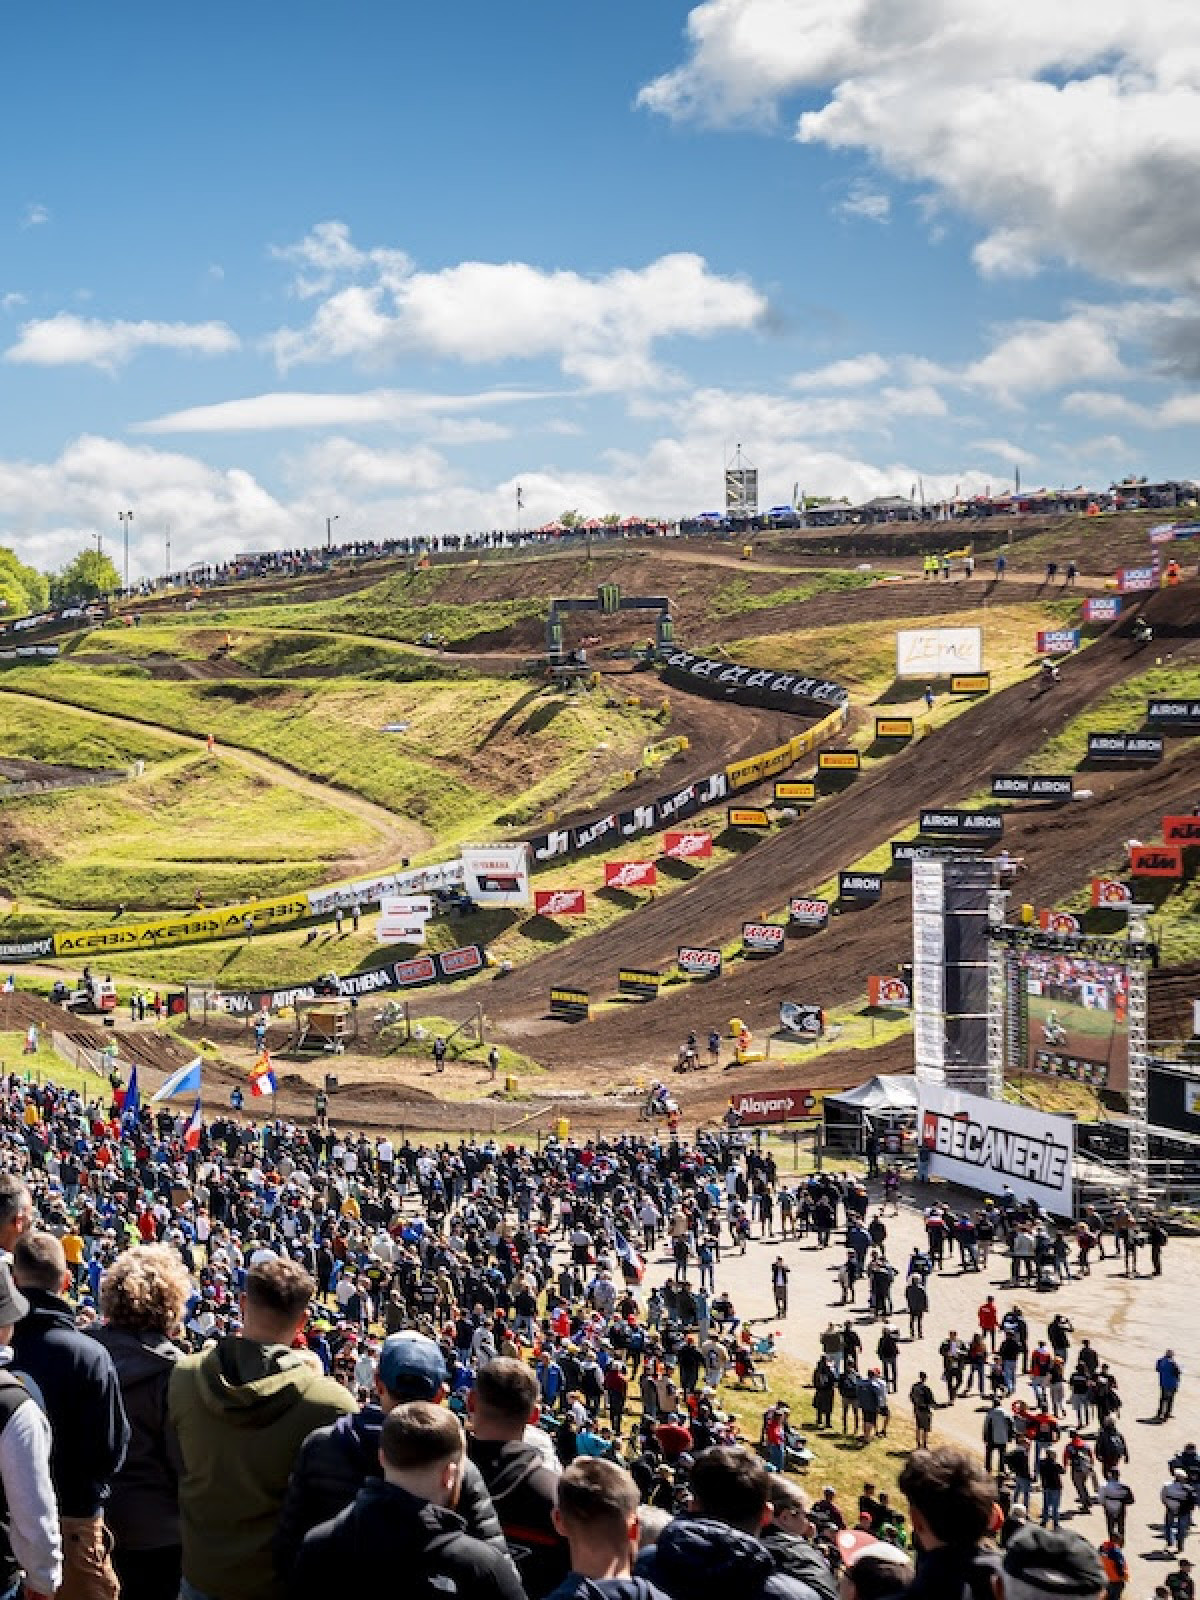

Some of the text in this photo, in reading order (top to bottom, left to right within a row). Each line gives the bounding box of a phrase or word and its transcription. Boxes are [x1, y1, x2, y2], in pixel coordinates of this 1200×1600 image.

[921, 815, 1002, 828] AIROH AIROH
[1137, 854, 1177, 869] KTM
[842, 877, 881, 890] AIROH
